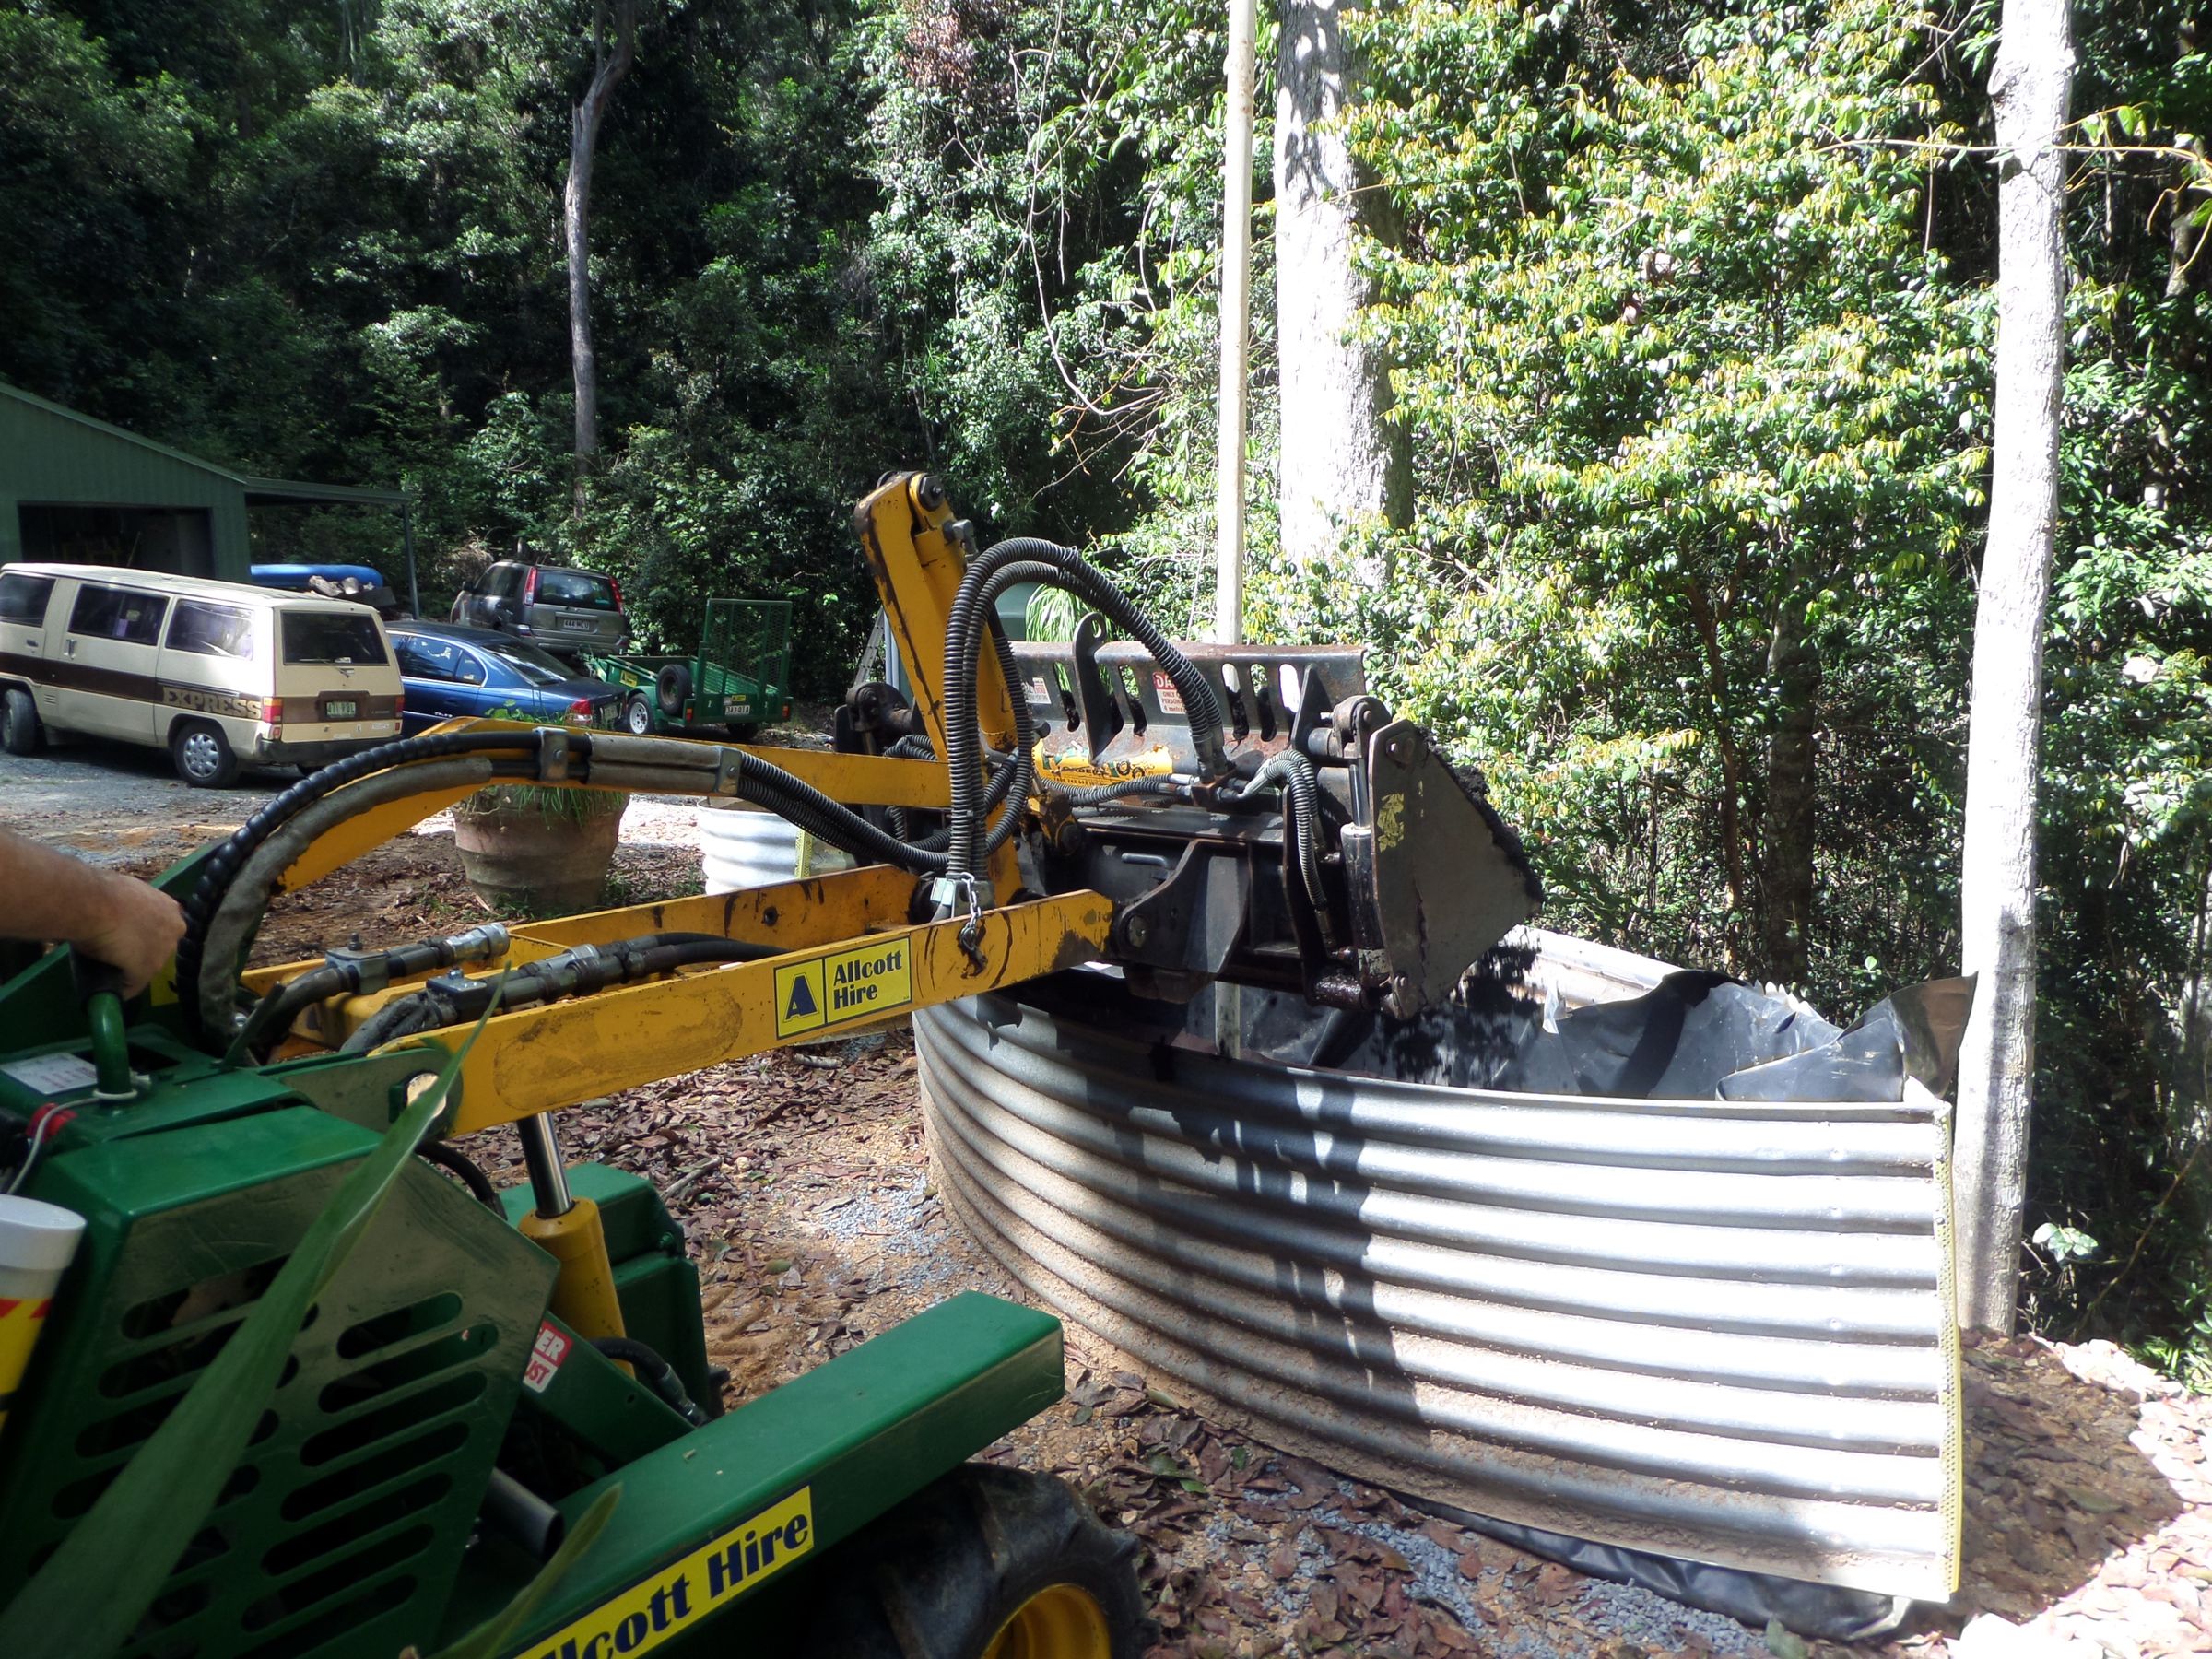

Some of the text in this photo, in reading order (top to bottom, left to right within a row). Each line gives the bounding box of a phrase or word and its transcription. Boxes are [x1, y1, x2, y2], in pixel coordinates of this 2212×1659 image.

[163, 687, 262, 720] EXPRESS
[833, 949, 902, 986] Allcott
[833, 983, 878, 1011] Hire
[535, 1327, 566, 1362] ER
[541, 1513, 808, 1659] lcott Hire
